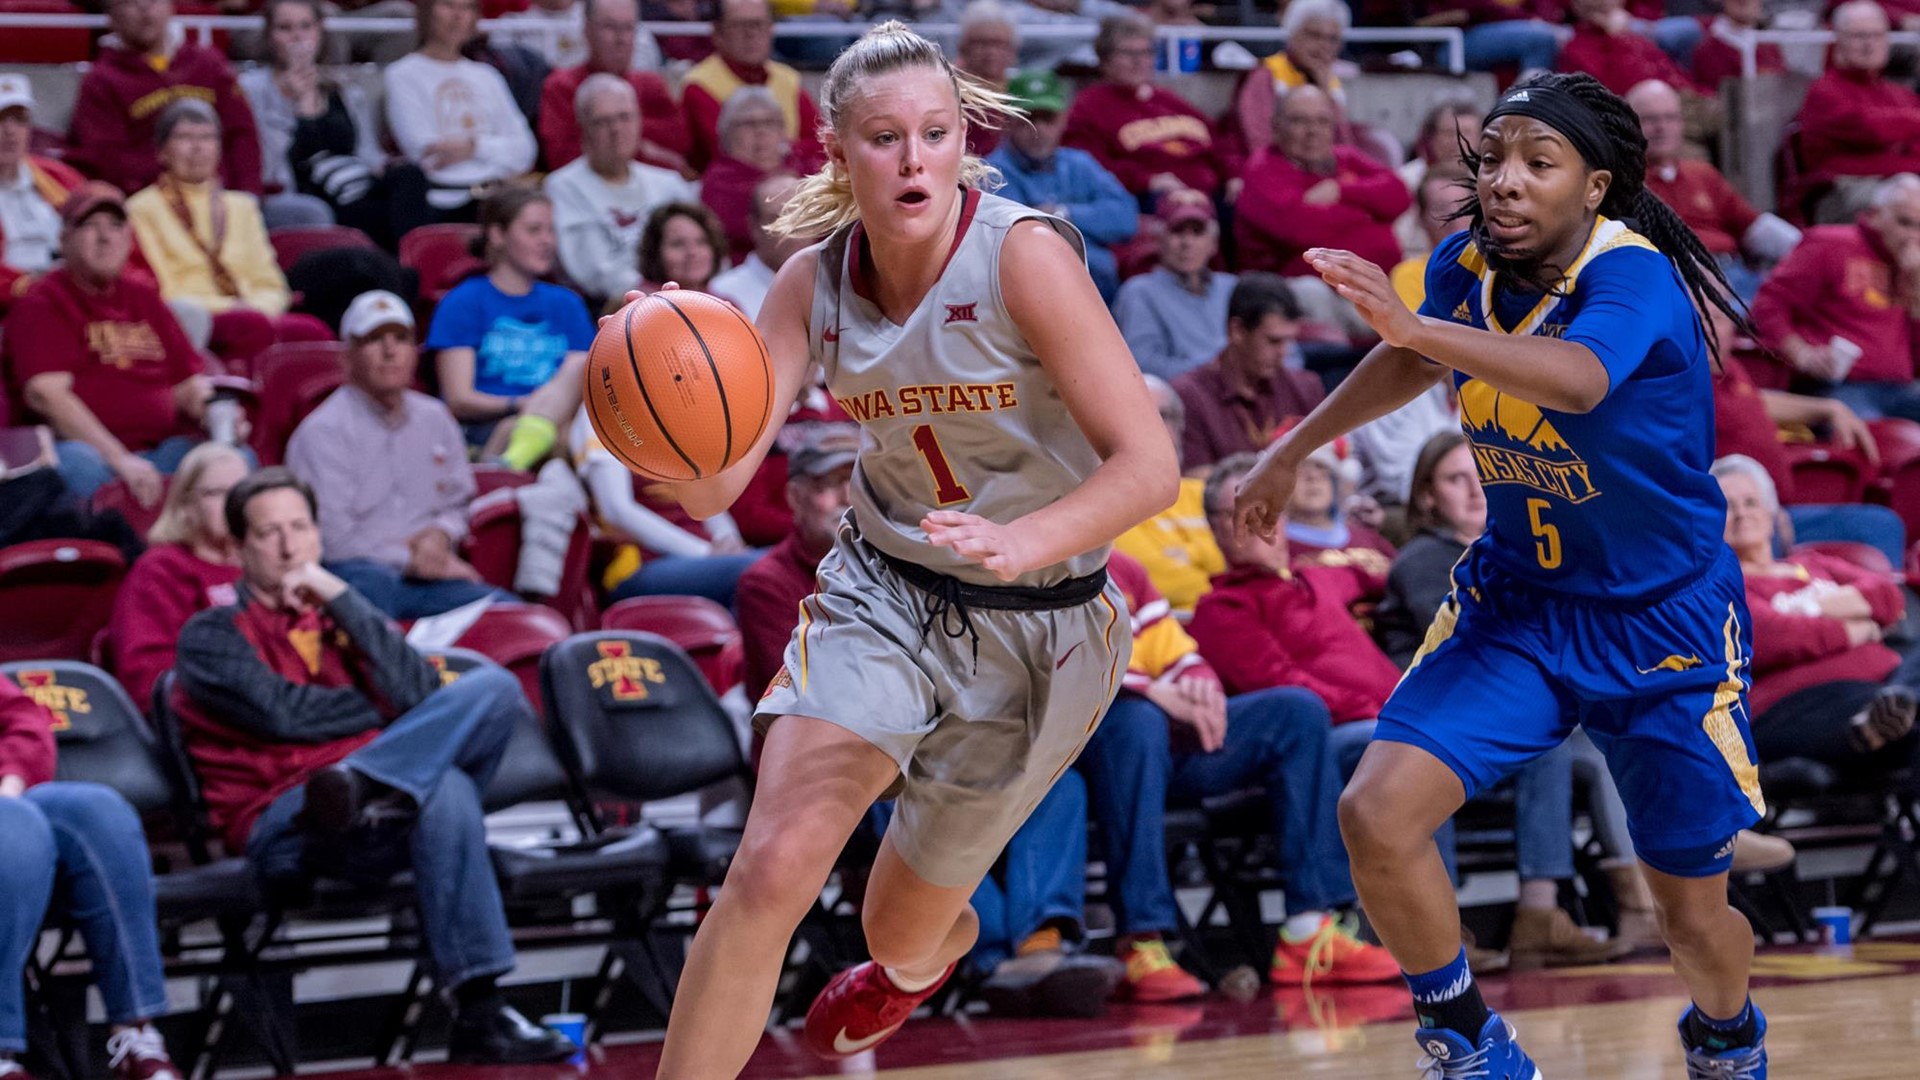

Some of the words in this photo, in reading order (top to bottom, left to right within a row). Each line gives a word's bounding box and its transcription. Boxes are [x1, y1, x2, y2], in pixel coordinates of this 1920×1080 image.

[898, 382, 1018, 415] STATE
[911, 424, 972, 506] 1
[1533, 460, 1596, 500] CITY
[1526, 497, 1562, 570] 5
